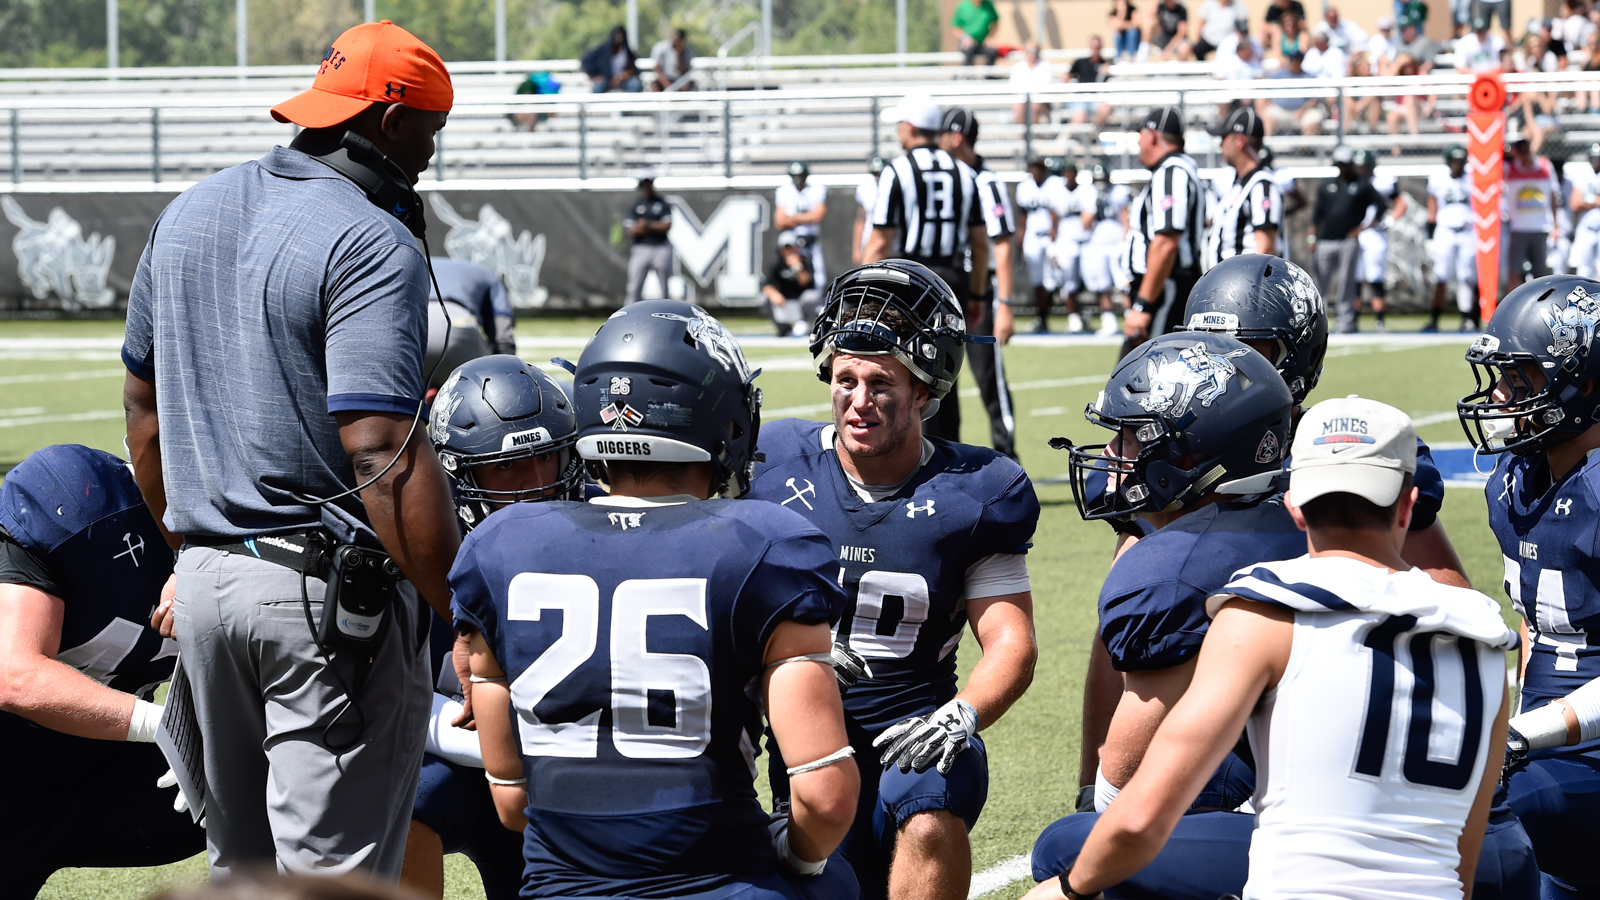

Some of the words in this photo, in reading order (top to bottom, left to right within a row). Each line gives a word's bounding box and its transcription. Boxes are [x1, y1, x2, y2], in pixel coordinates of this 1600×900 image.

[922, 171, 955, 220] R
[1203, 315, 1226, 325] MINES
[610, 376, 631, 395] 26
[1322, 417, 1368, 435] MINES
[512, 431, 541, 446] MINES
[1325, 435, 1362, 443] FOOTBALL
[596, 440, 651, 456] DIGGERS
[840, 545, 876, 563] MINES
[831, 567, 930, 658] 0
[507, 571, 712, 759] 26
[1349, 613, 1486, 796] 10
